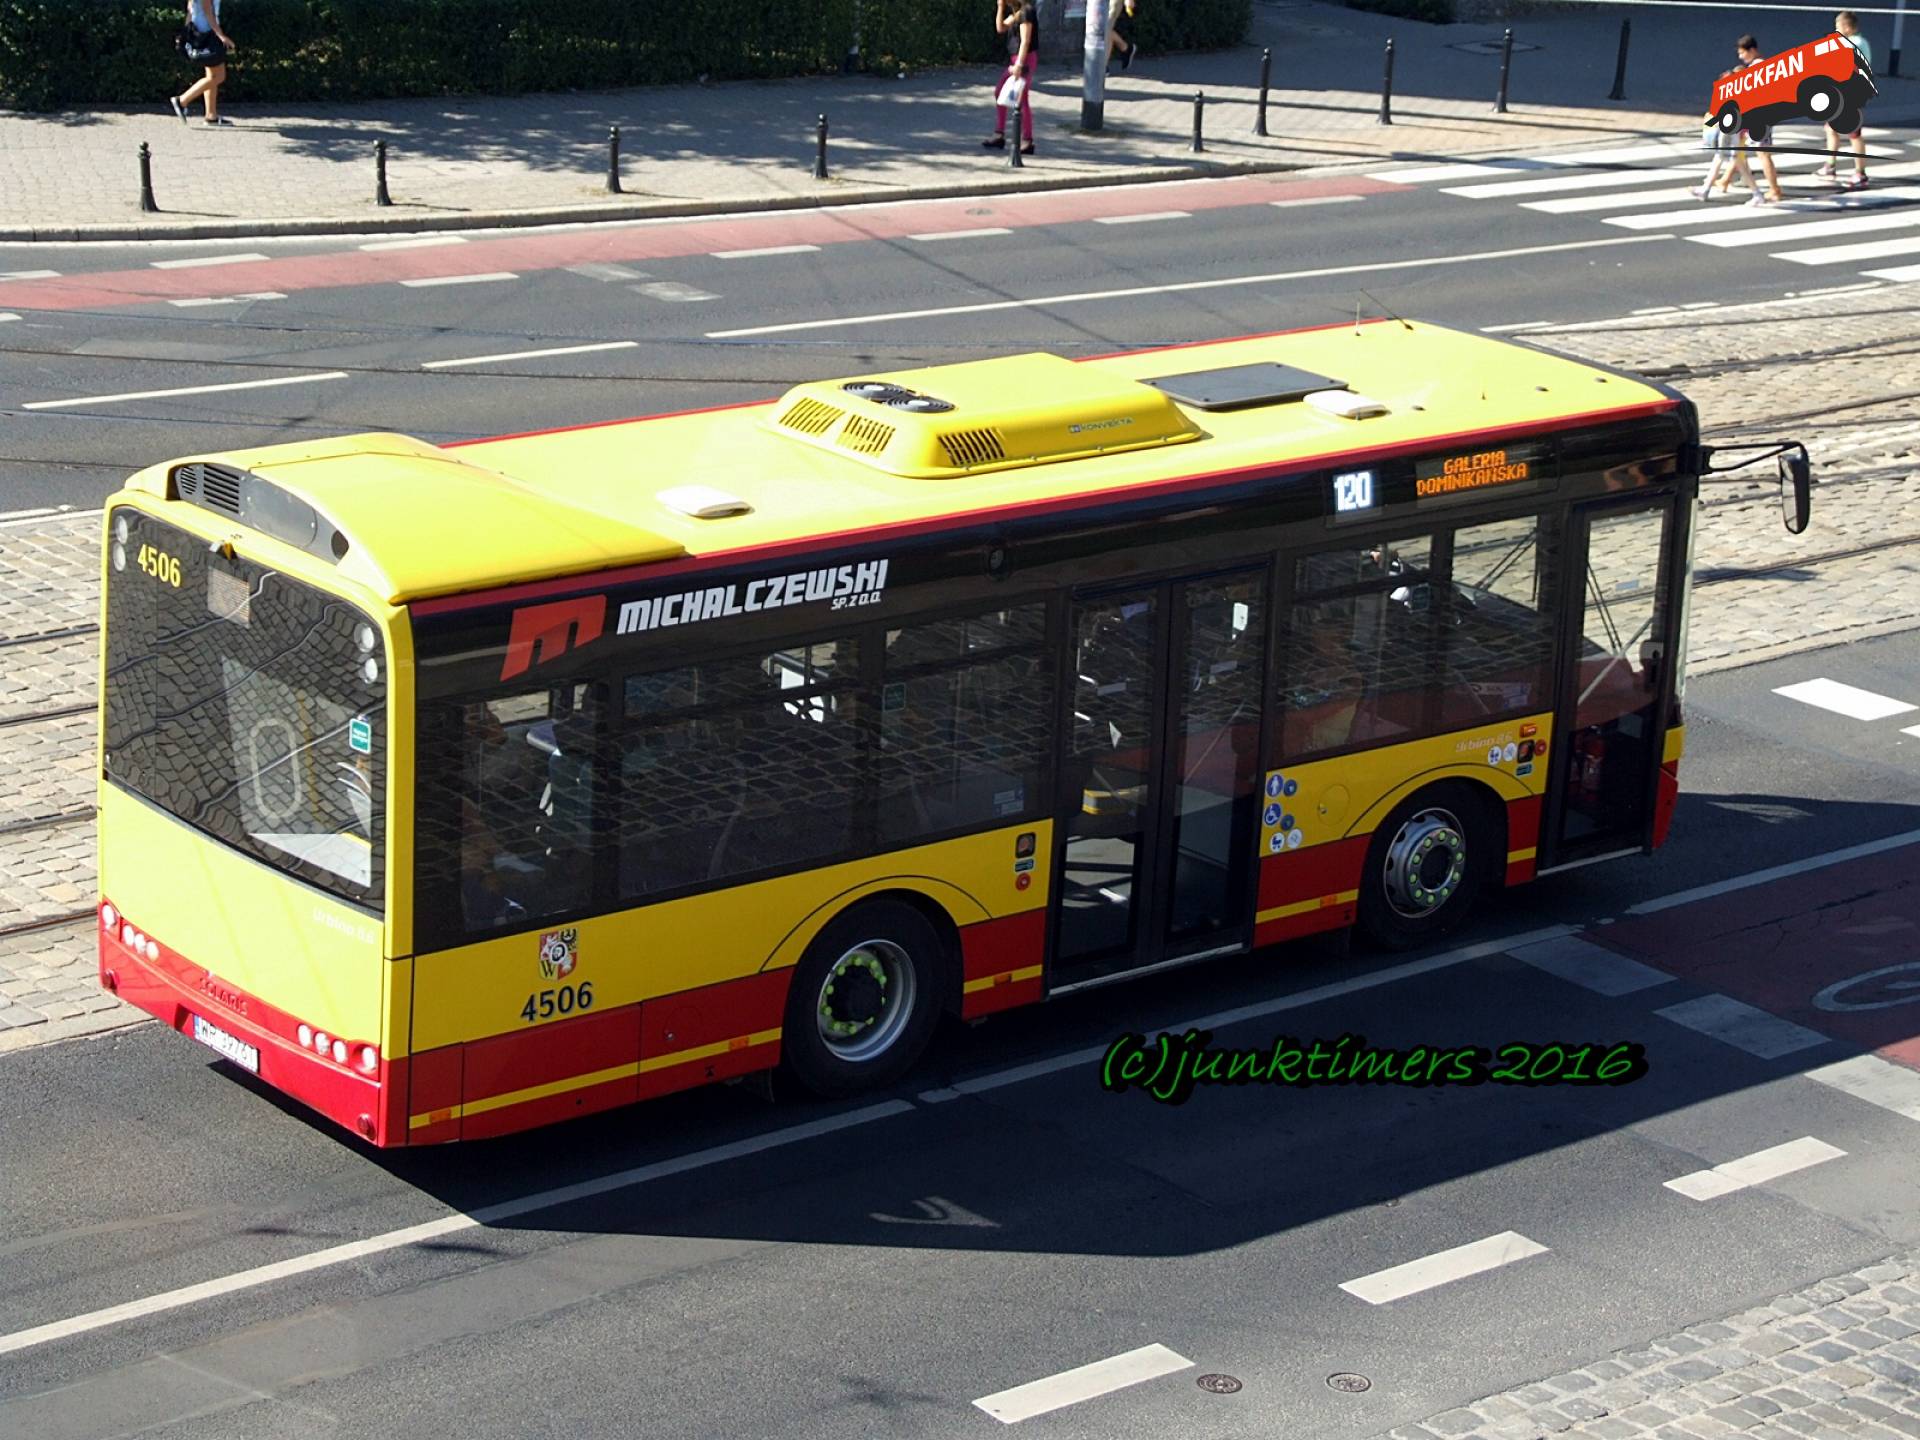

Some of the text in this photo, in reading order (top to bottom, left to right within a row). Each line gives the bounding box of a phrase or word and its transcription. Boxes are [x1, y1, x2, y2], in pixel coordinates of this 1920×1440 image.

[1443, 450, 1506, 475] GALERIA
[1334, 471, 1372, 512] 120
[137, 543, 181, 588] 4506
[616, 559, 889, 634] MICHALCZEWSKI
[199, 977, 249, 1017] SOLARIS
[521, 981, 593, 1021] 4506
